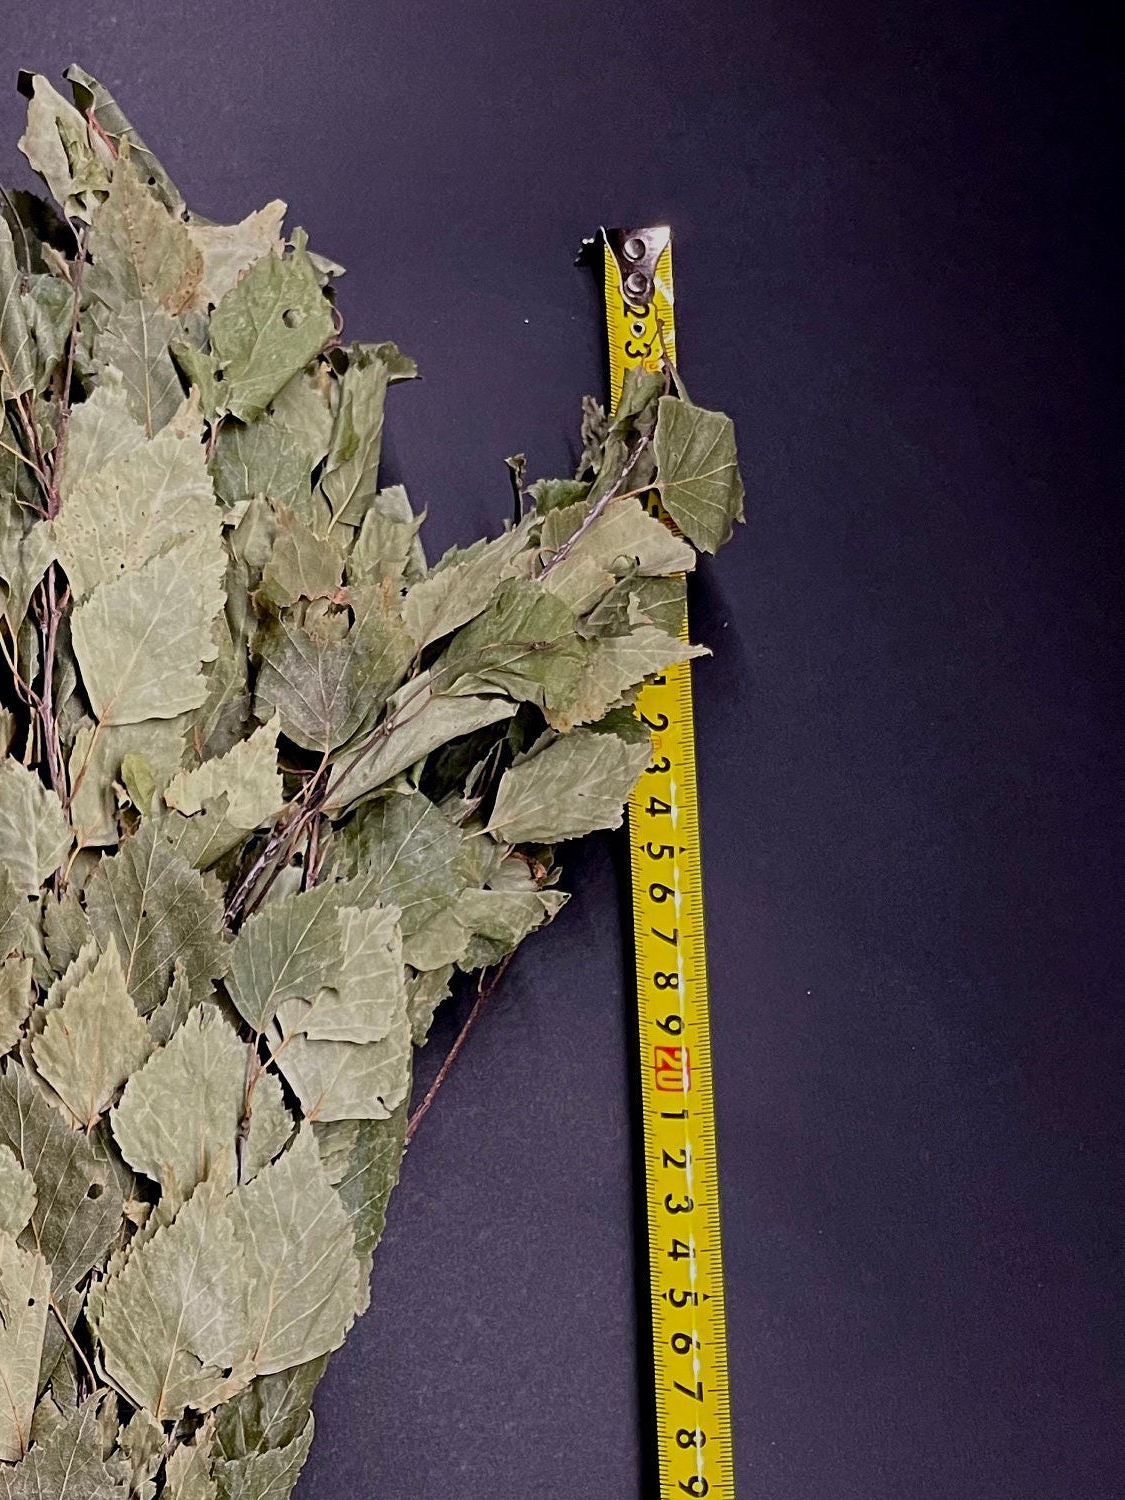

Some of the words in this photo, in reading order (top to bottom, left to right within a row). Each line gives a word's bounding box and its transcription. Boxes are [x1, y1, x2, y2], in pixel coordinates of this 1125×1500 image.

[625, 341, 651, 358] 3
[641, 712, 668, 731] 2
[645, 757, 670, 774] 3
[645, 796, 672, 817] 4
[647, 842, 674, 860] 5
[649, 883, 675, 903] 6
[651, 927, 679, 947] 7
[654, 972, 679, 990] 8
[656, 1015, 684, 1035] 9
[658, 1049, 688, 1088] 20
[661, 1109, 688, 1119] 1
[662, 1149, 691, 1168] 2
[664, 1194, 694, 1214] 3
[667, 1239, 695, 1261] 4
[669, 1288, 698, 1308] 5
[671, 1333, 701, 1354] 6
[673, 1381, 703, 1402] 7
[676, 1429, 706, 1449] 8
[678, 1476, 708, 1498] 9
